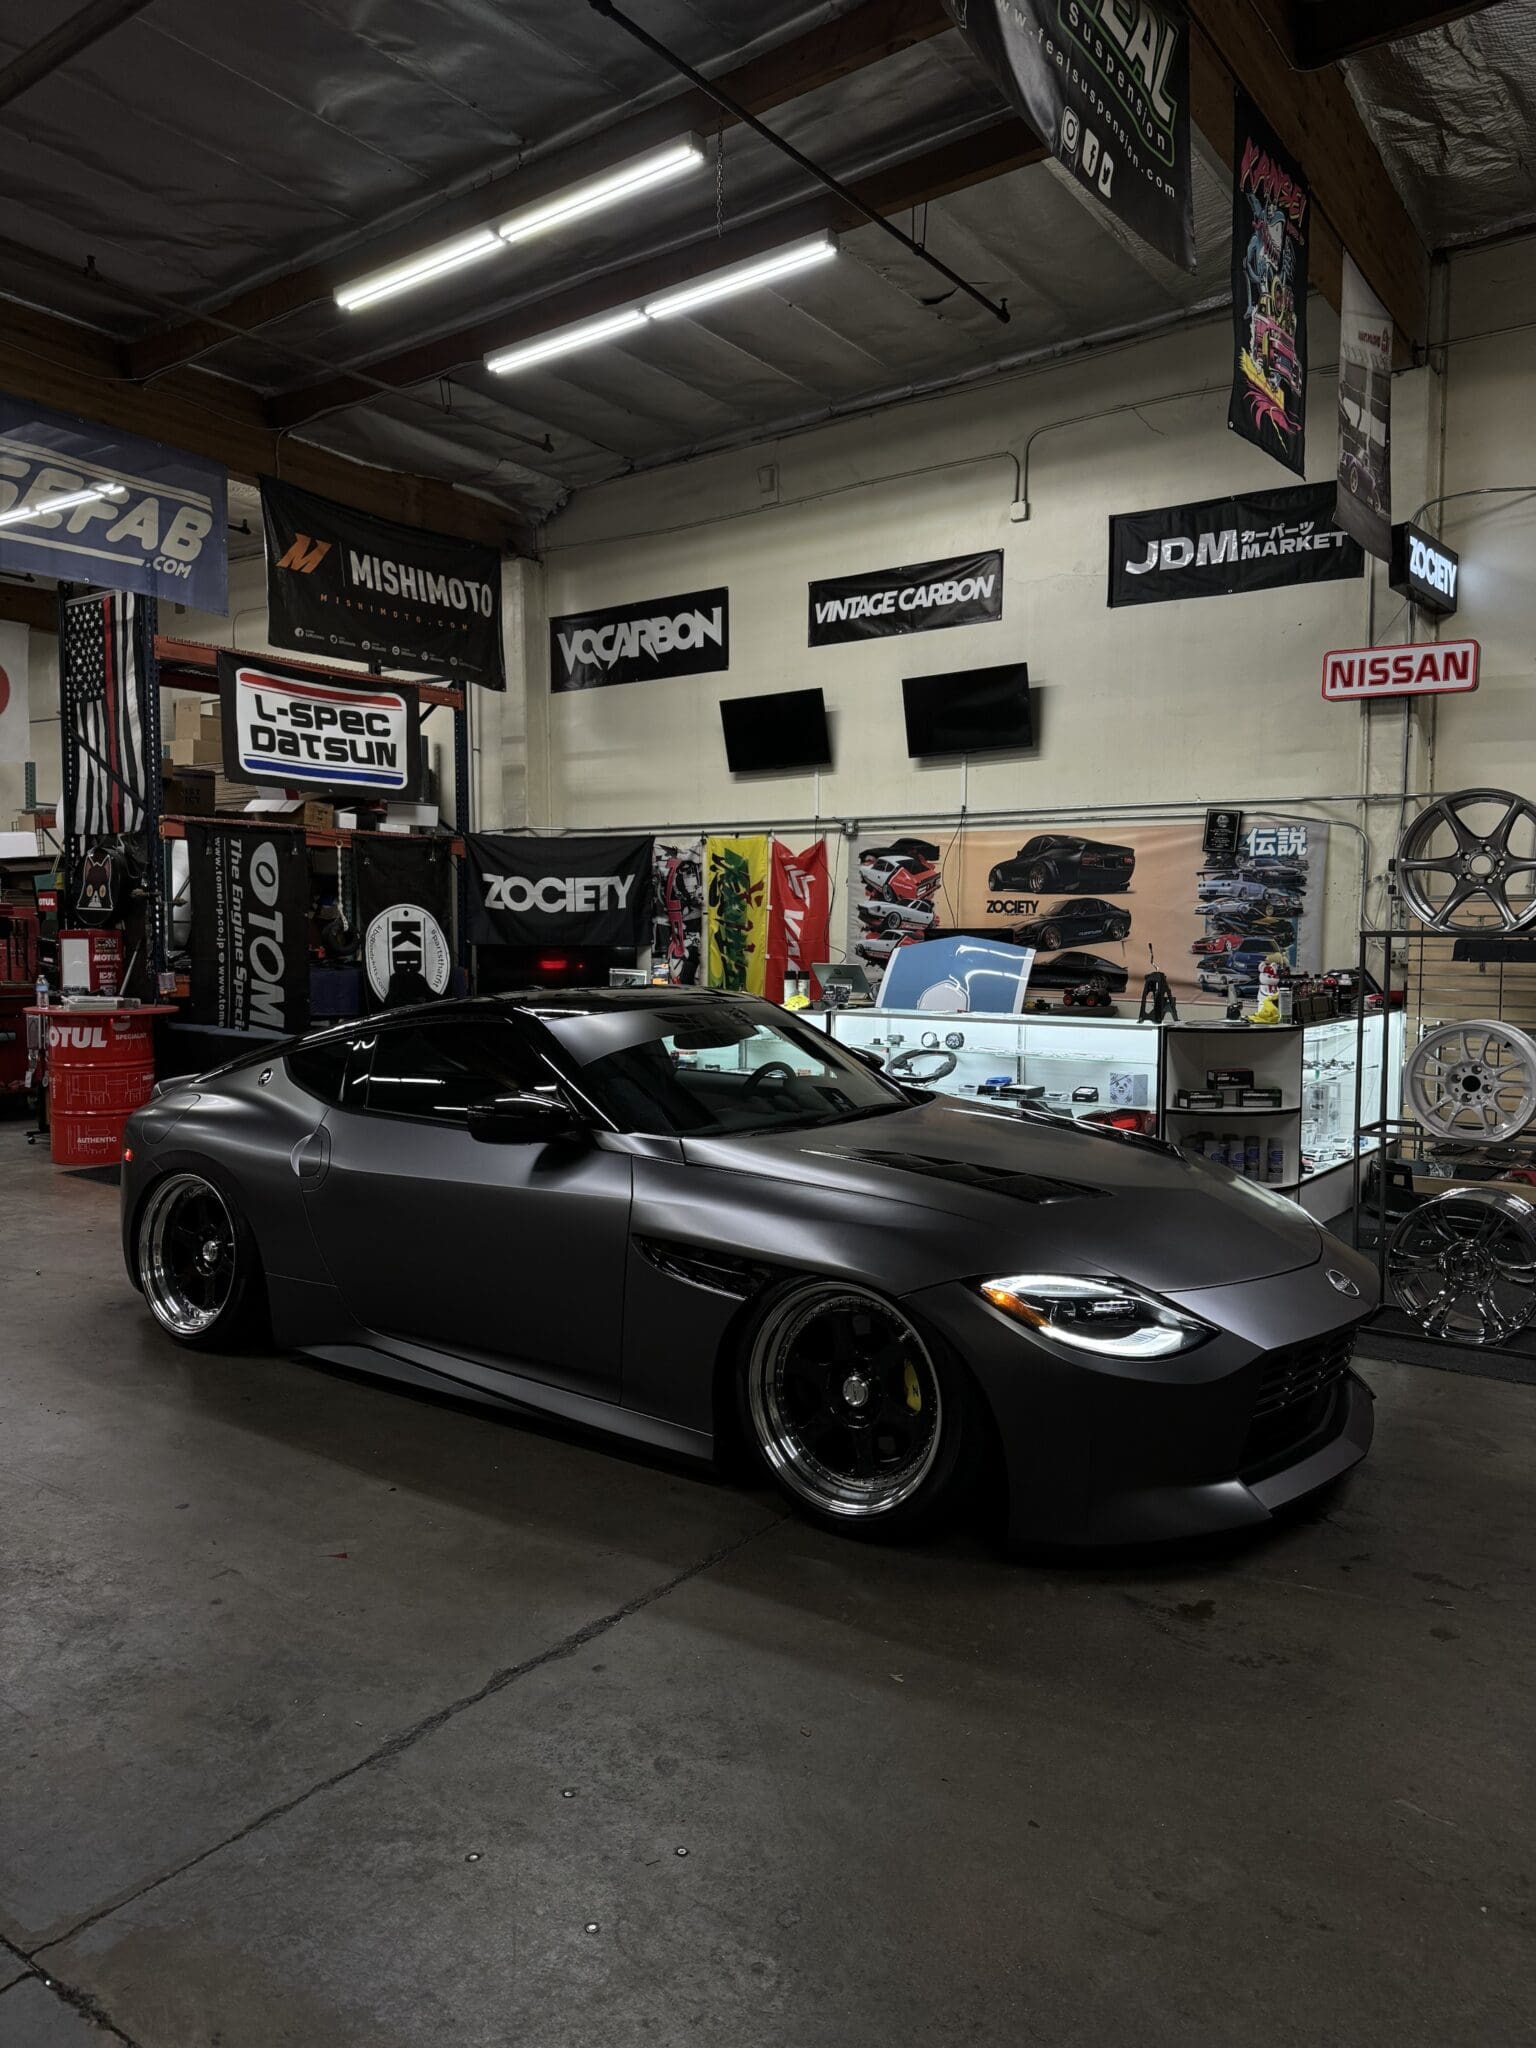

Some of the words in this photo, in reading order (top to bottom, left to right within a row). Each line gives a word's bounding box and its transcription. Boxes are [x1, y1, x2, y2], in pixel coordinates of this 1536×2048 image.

[1069, 2, 1166, 151] Suspension
[1099, 0, 1175, 122] EAL
[1240, 531, 1348, 559] MARKET
[1241, 521, 1315, 542] カーパーツ
[1126, 530, 1238, 575] JDM
[1409, 536, 1457, 598] ZOCIETY
[350, 550, 494, 618] MISHIMOTO
[815, 590, 899, 625] VINTAGE
[899, 574, 995, 612] CARBON
[1329, 650, 1470, 689] NISSAN
[230, 838, 242, 880] The
[1247, 826, 1307, 857] 伝説
[38, 898, 56, 906] OTUL
[482, 873, 636, 913] ZOCIETY
[986, 900, 1040, 914] ZOCIETY
[231, 884, 245, 962] Engine
[93, 954, 121, 962] MOTUL
[50, 1027, 108, 1049] OTUL
[77, 1136, 117, 1144] AUTHENTIC
